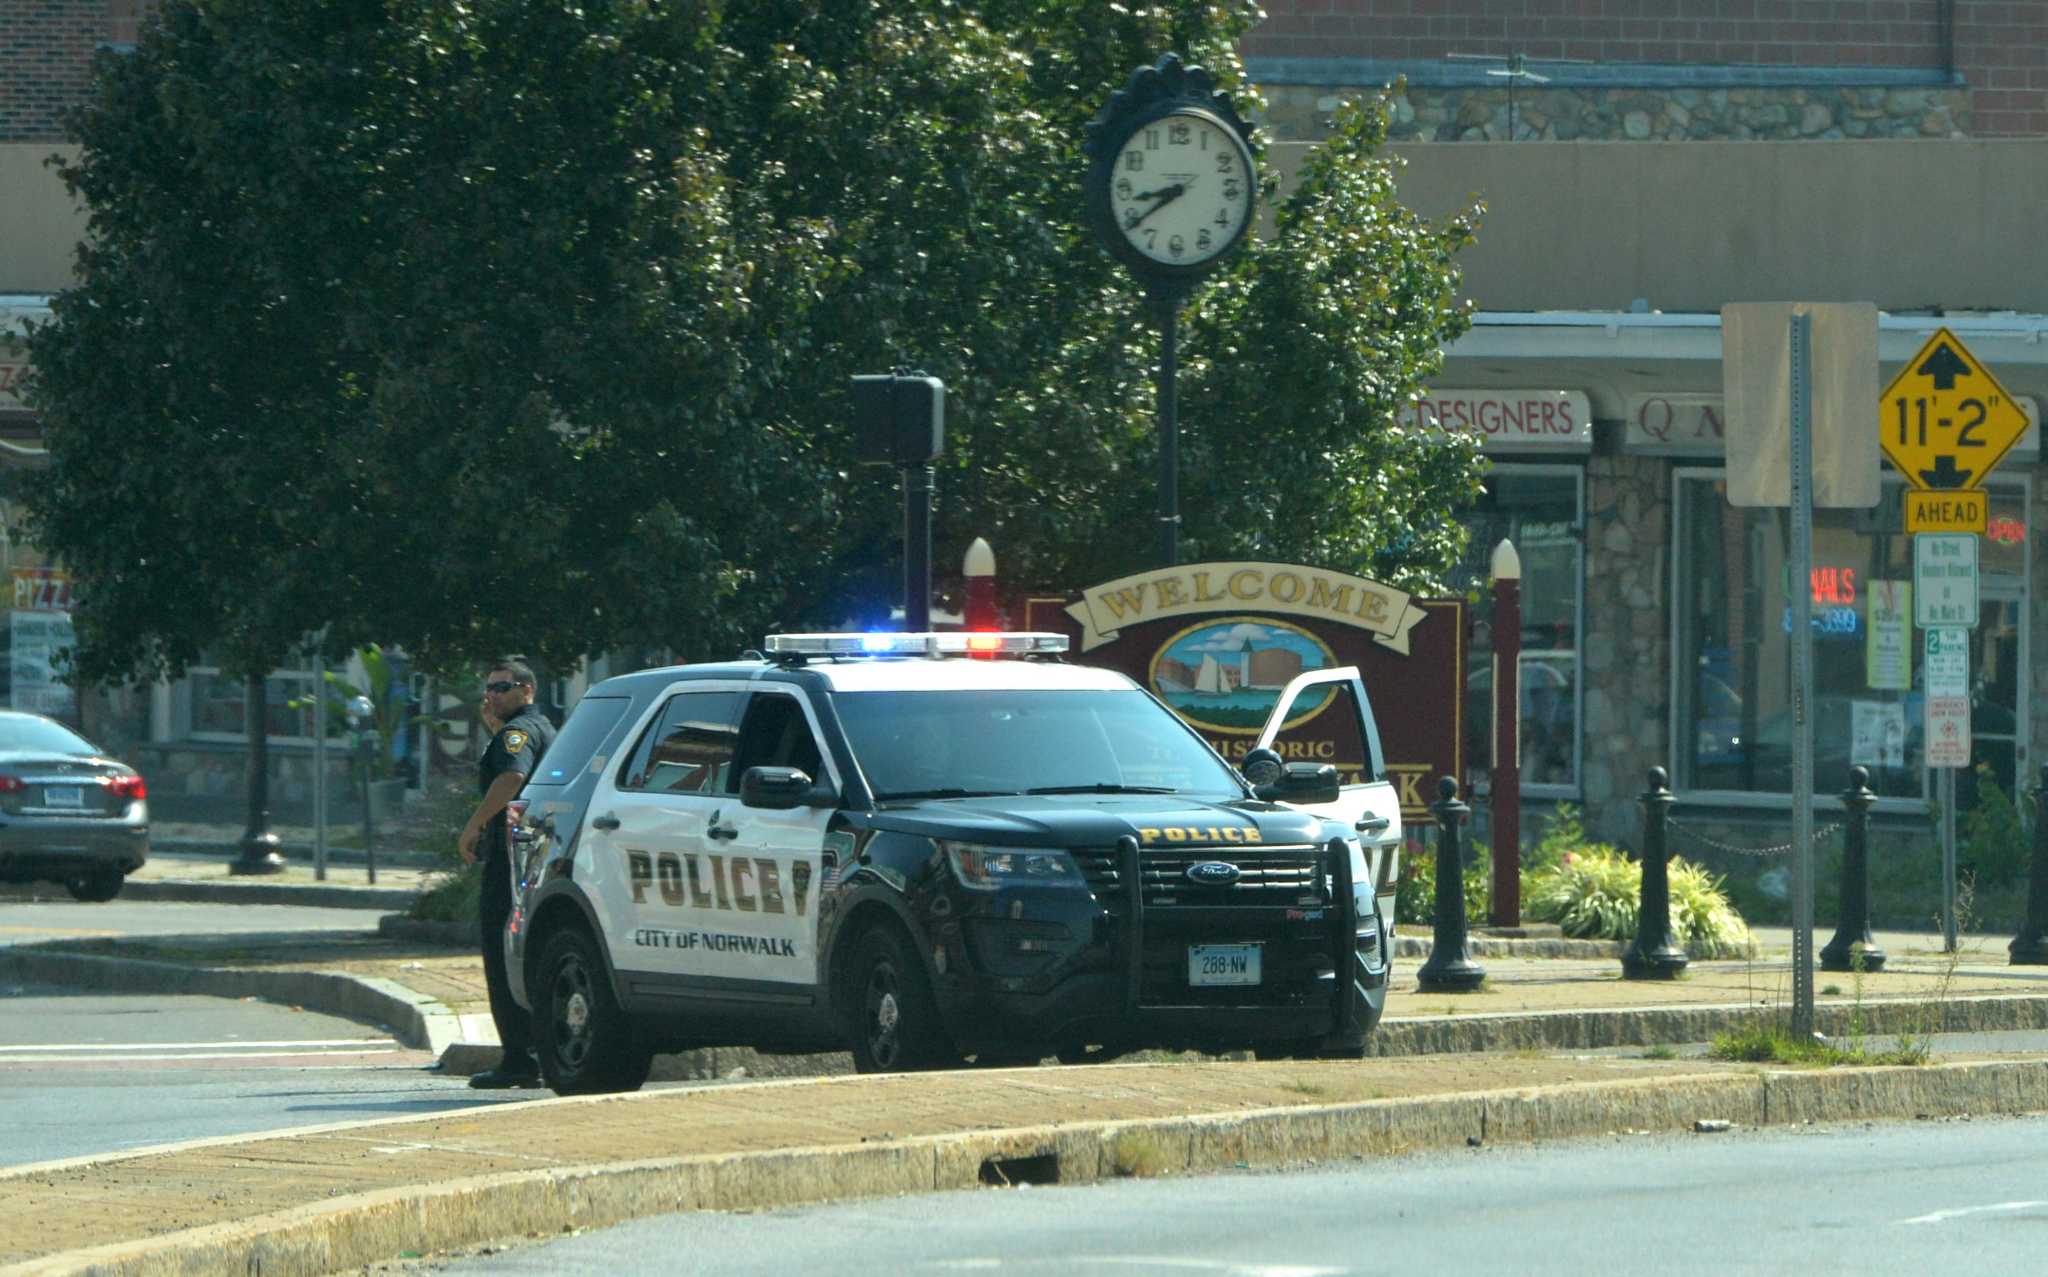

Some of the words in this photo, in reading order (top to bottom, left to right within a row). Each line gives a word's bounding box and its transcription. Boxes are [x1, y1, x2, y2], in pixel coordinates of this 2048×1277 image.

[1145, 130, 1160, 150] 11
[1216, 152, 1232, 173] 2
[1142, 228, 1157, 249] 7
[1416, 399, 1574, 434] DESIGNERS
[1916, 502, 1978, 522] AHEAD
[14, 576, 72, 609] PIZZ
[1098, 569, 1390, 624] WELCOME
[1139, 827, 1263, 843] POLICE
[626, 849, 785, 914] POLICE
[635, 929, 672, 948] CITY
[677, 932, 698, 948] OF
[702, 933, 796, 958] NORWALK
